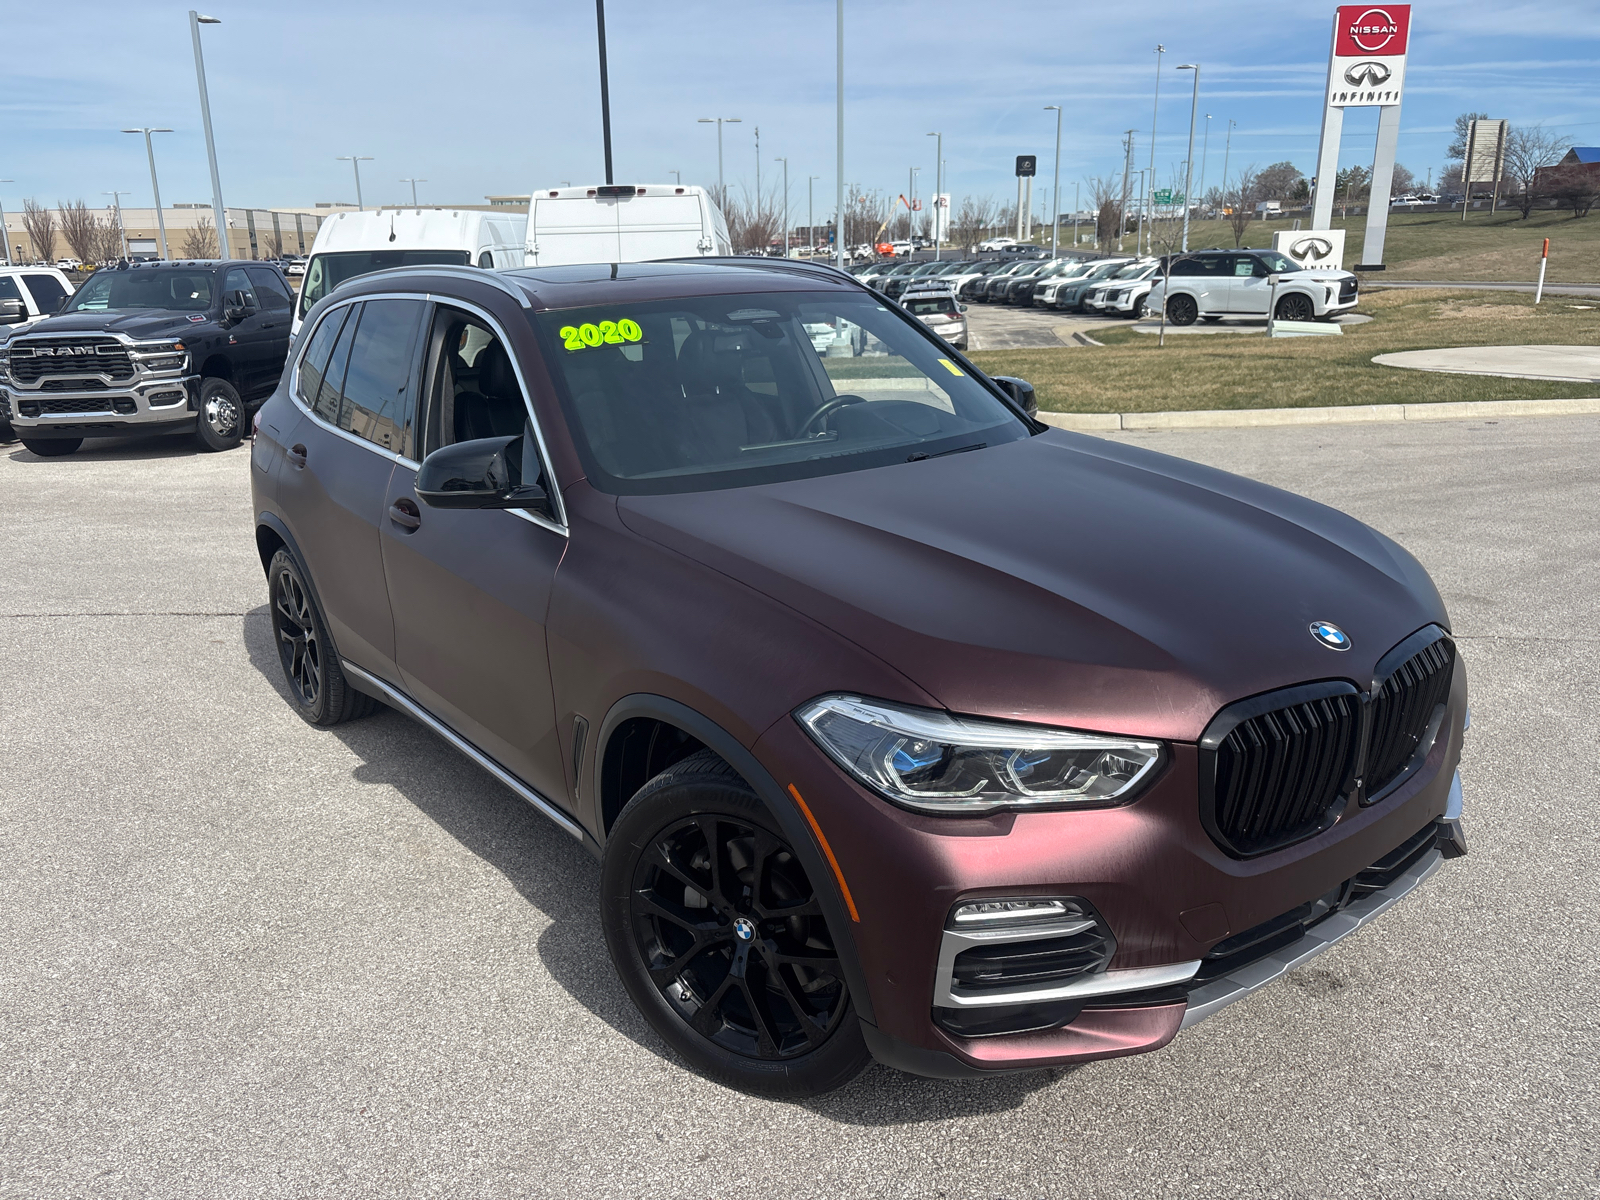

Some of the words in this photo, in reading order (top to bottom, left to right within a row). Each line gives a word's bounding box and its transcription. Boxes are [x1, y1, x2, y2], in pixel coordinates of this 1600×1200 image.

[1350, 26, 1398, 34] NISSAN
[1332, 91, 1399, 102] INFINITI
[560, 319, 643, 351] 2020
[36, 346, 95, 357] RAM
